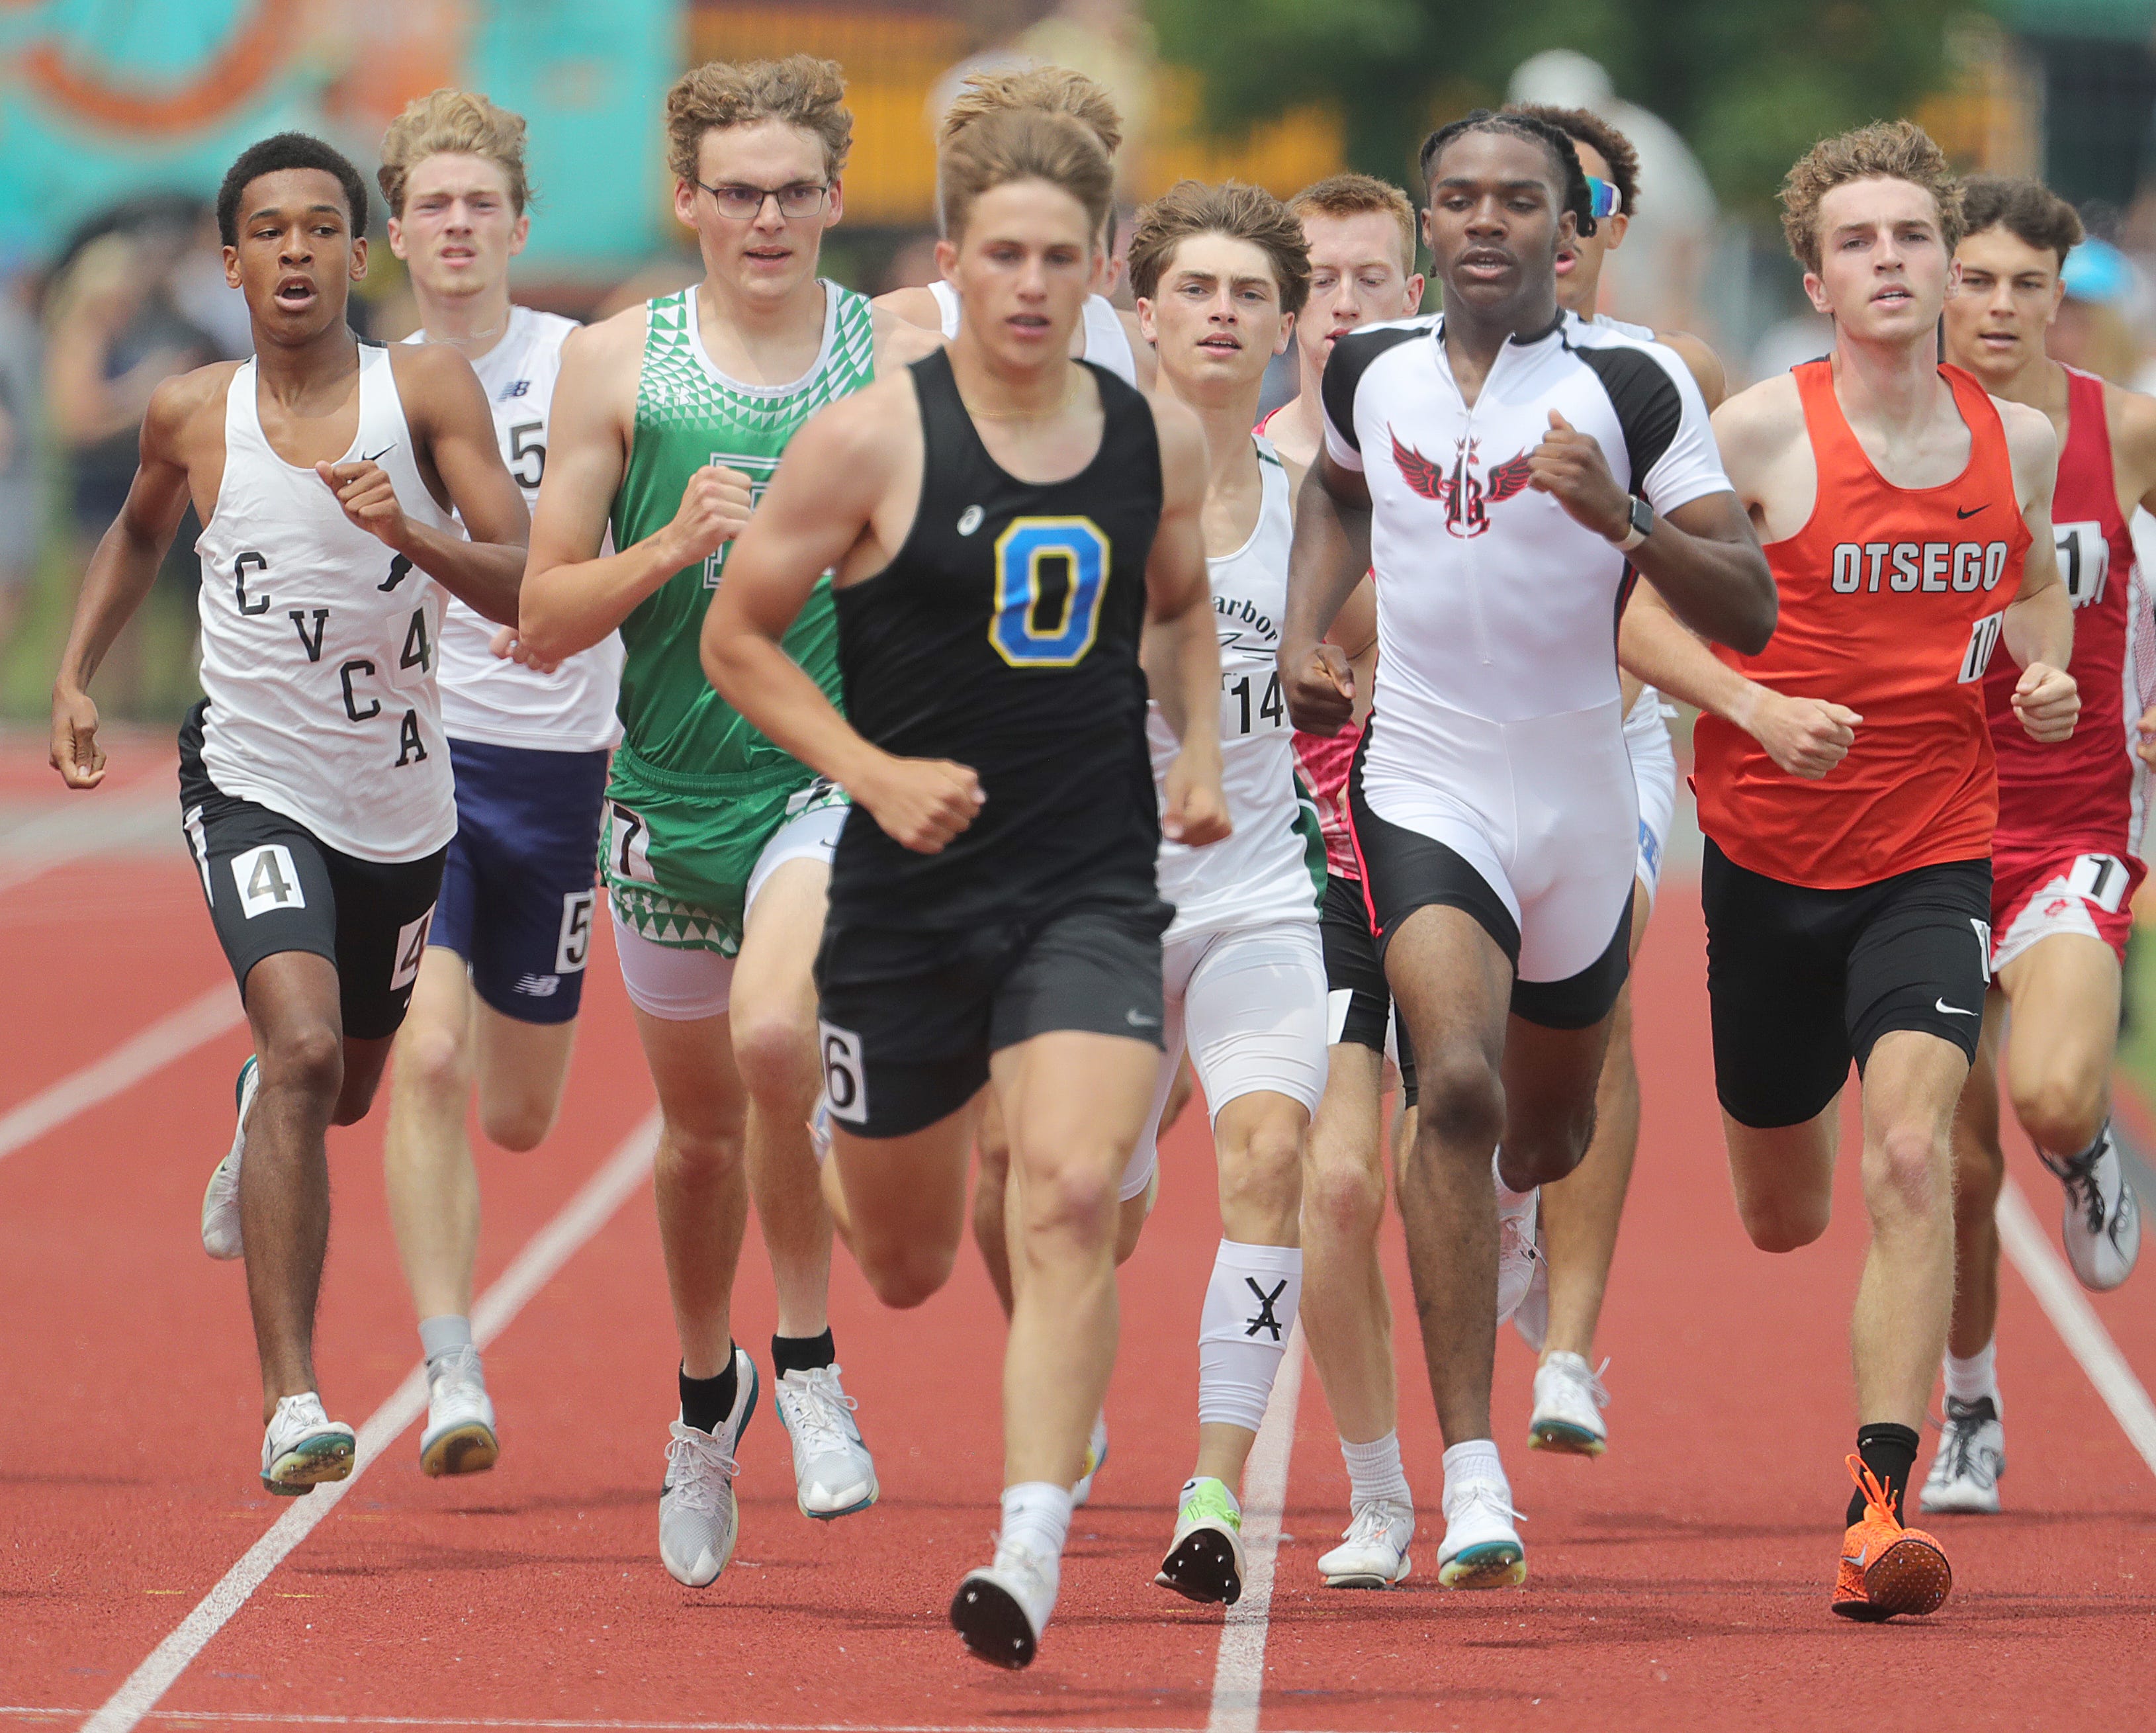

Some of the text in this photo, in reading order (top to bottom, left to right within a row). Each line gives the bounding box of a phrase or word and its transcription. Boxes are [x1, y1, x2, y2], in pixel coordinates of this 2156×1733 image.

[510, 421, 546, 489] 5
[1832, 541, 2008, 593] OTSEGO
[399, 607, 430, 674] 4
[1968, 617, 1997, 679] 10
[1231, 670, 1284, 734] 14
[610, 804, 642, 875] 7
[246, 850, 292, 903] 4
[2089, 855, 2114, 898] 1
[400, 912, 430, 973] 4
[569, 900, 591, 963] 5
[823, 1034, 859, 1110] 6
